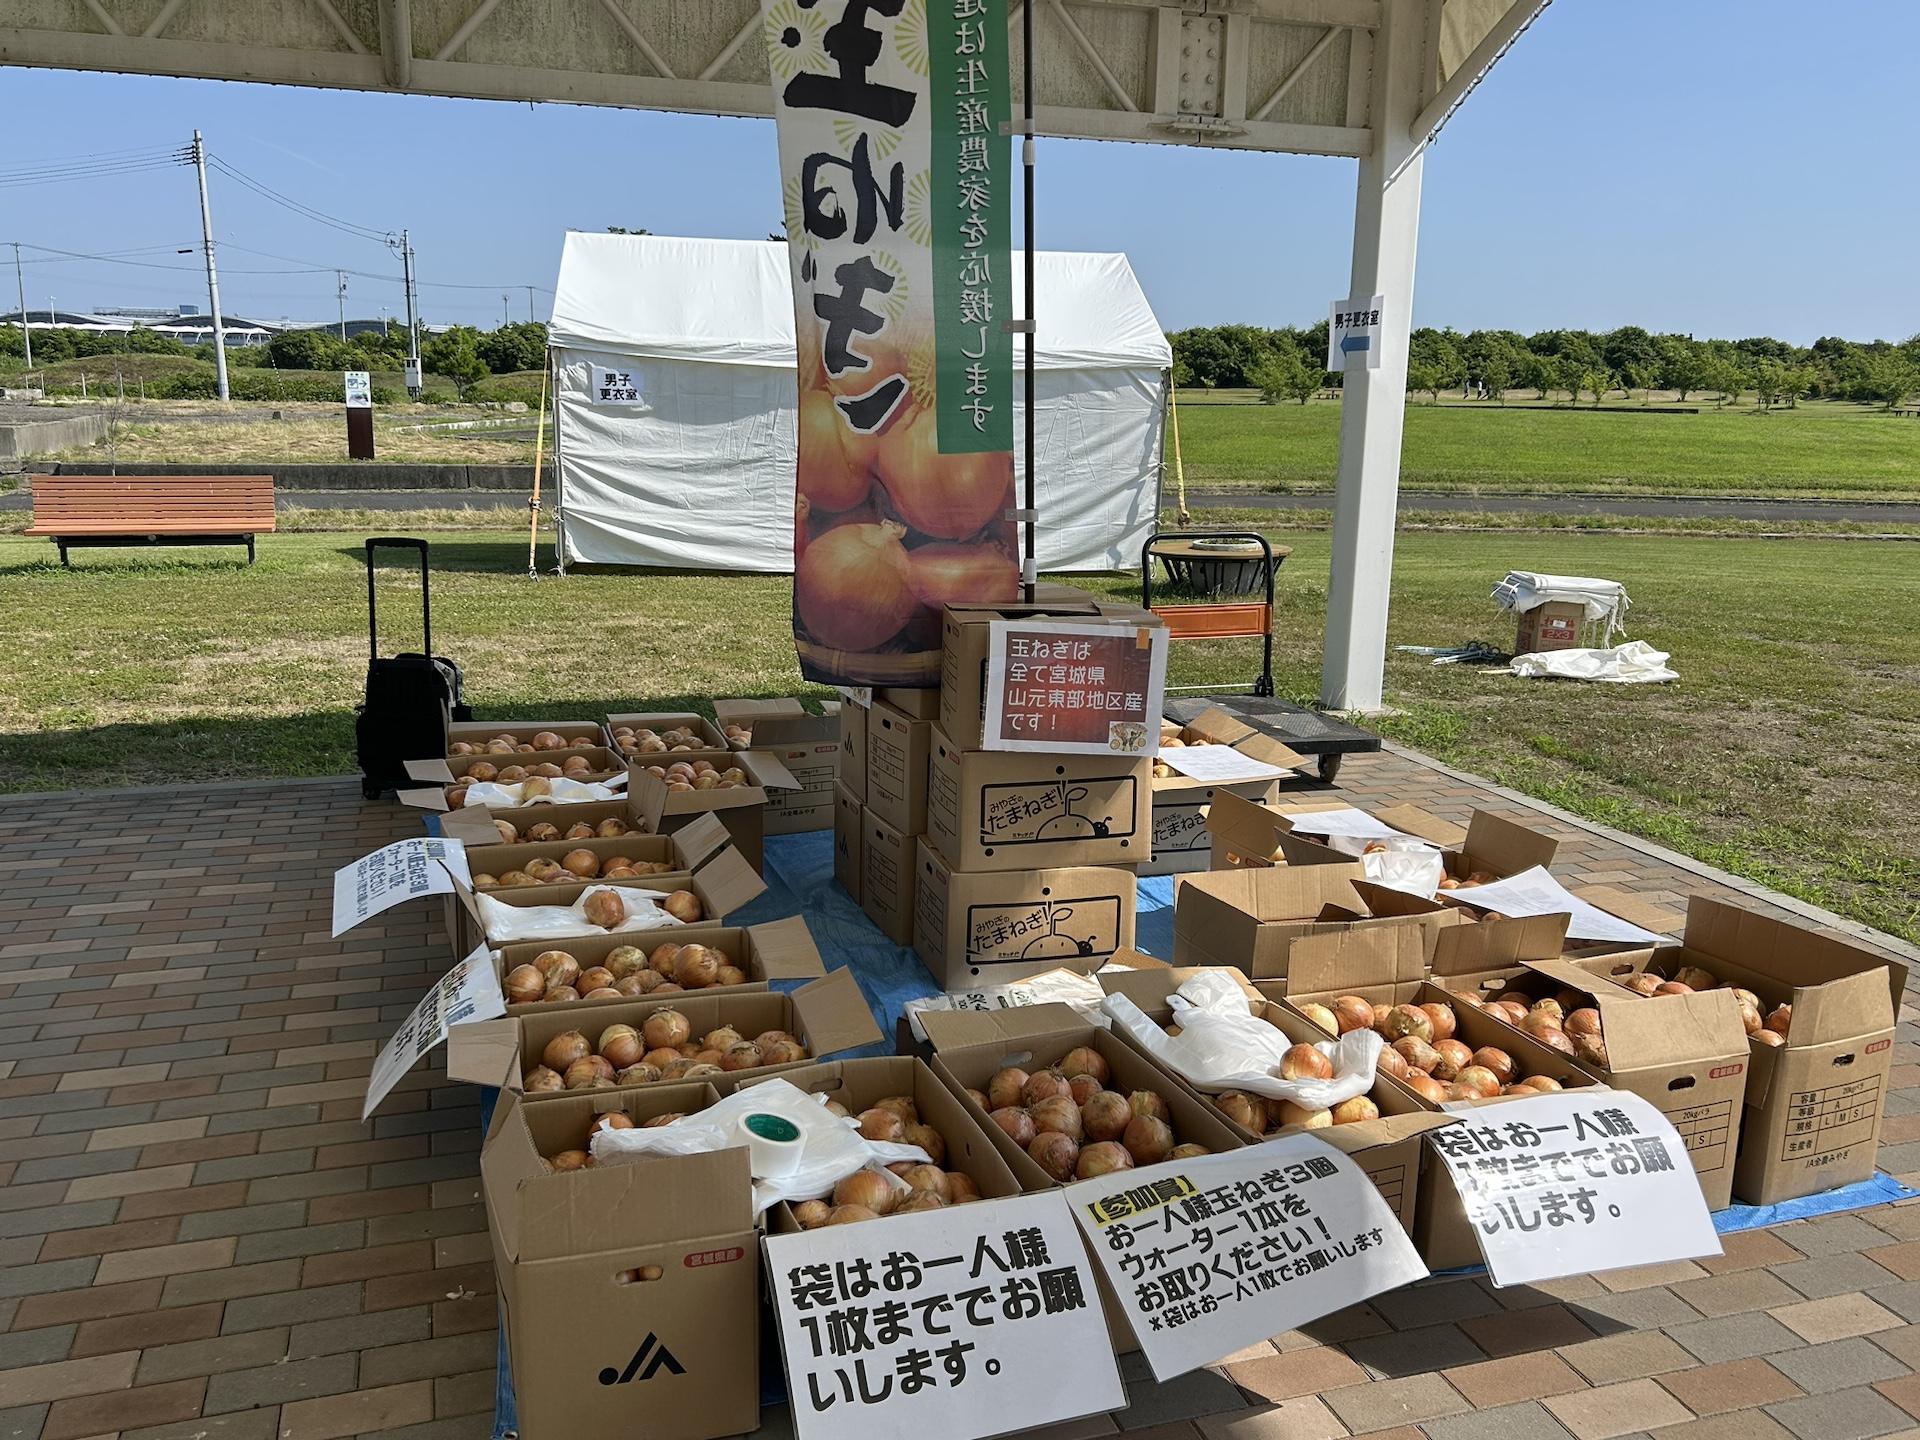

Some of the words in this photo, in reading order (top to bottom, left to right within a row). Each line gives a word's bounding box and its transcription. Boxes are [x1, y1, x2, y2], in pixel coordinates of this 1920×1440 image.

[1335, 310, 1380, 329] 男子更衣室
[604, 373, 632, 386] 男子
[600, 388, 638, 400] 更衣室
[1011, 638, 1091, 660] 玉ねぎは
[1009, 662, 1106, 686] 全て宮城県
[1008, 688, 1143, 712] 山元東部地区産
[1006, 712, 1056, 731] です！
[989, 794, 1024, 813] みやぎの
[976, 914, 1010, 933] みやぎの
[1834, 1101, 1840, 1110] A
[1853, 1109, 1859, 1118] S
[1825, 1116, 1830, 1125] L
[1839, 1113, 1847, 1122] M
[1432, 1108, 1640, 1157] 袋はお一人様
[1699, 1135, 1705, 1144] S
[1087, 1174, 1198, 1224] 【参加賞】
[1104, 1155, 1339, 1251] お一人様玉ねぎ3個
[1480, 1187, 1622, 1235] いします。
[1118, 1191, 1311, 1280] ウォーター1本を
[788, 1226, 1052, 1311] 袋はお一人様
[1134, 1216, 1333, 1313] お取りください！
[799, 1265, 1087, 1358] 1枚まででお願
[807, 1339, 1001, 1412] いします。
